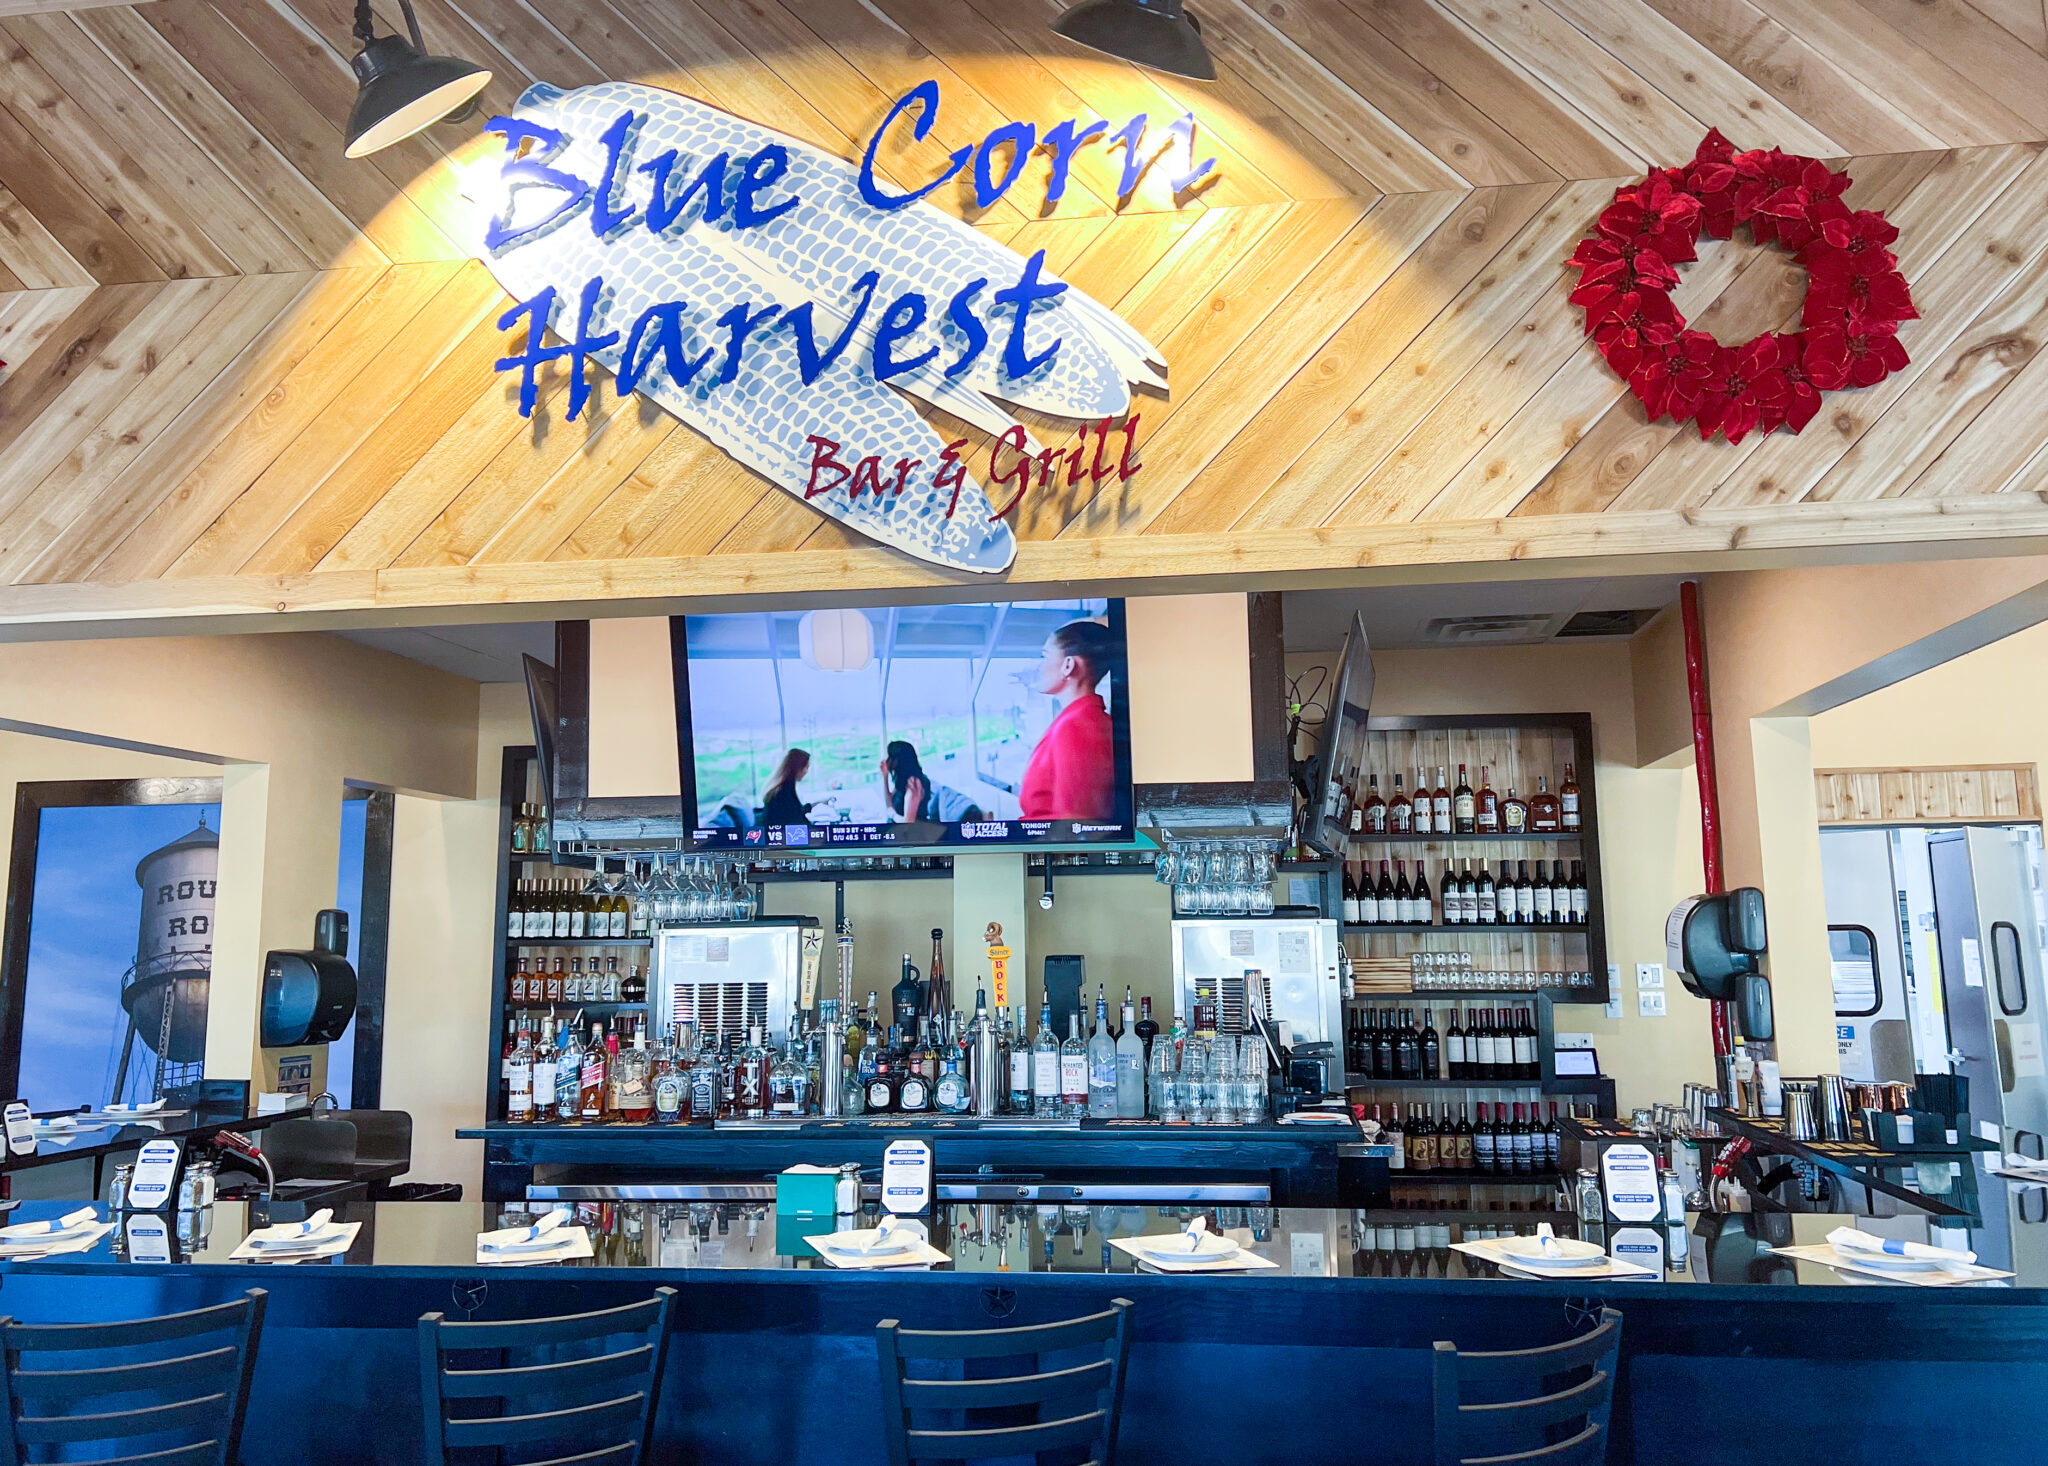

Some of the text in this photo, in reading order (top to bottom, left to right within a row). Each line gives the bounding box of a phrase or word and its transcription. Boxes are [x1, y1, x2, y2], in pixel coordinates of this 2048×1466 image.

[483, 79, 1222, 252] Blue Corn
[494, 248, 1069, 422] Harvest
[804, 414, 1144, 523] Bar & Grill
[768, 831, 783, 841] VS
[975, 830, 1008, 838] ACCESS
[976, 822, 1009, 831] TOTAL
[995, 960, 1005, 1002] BOCK
